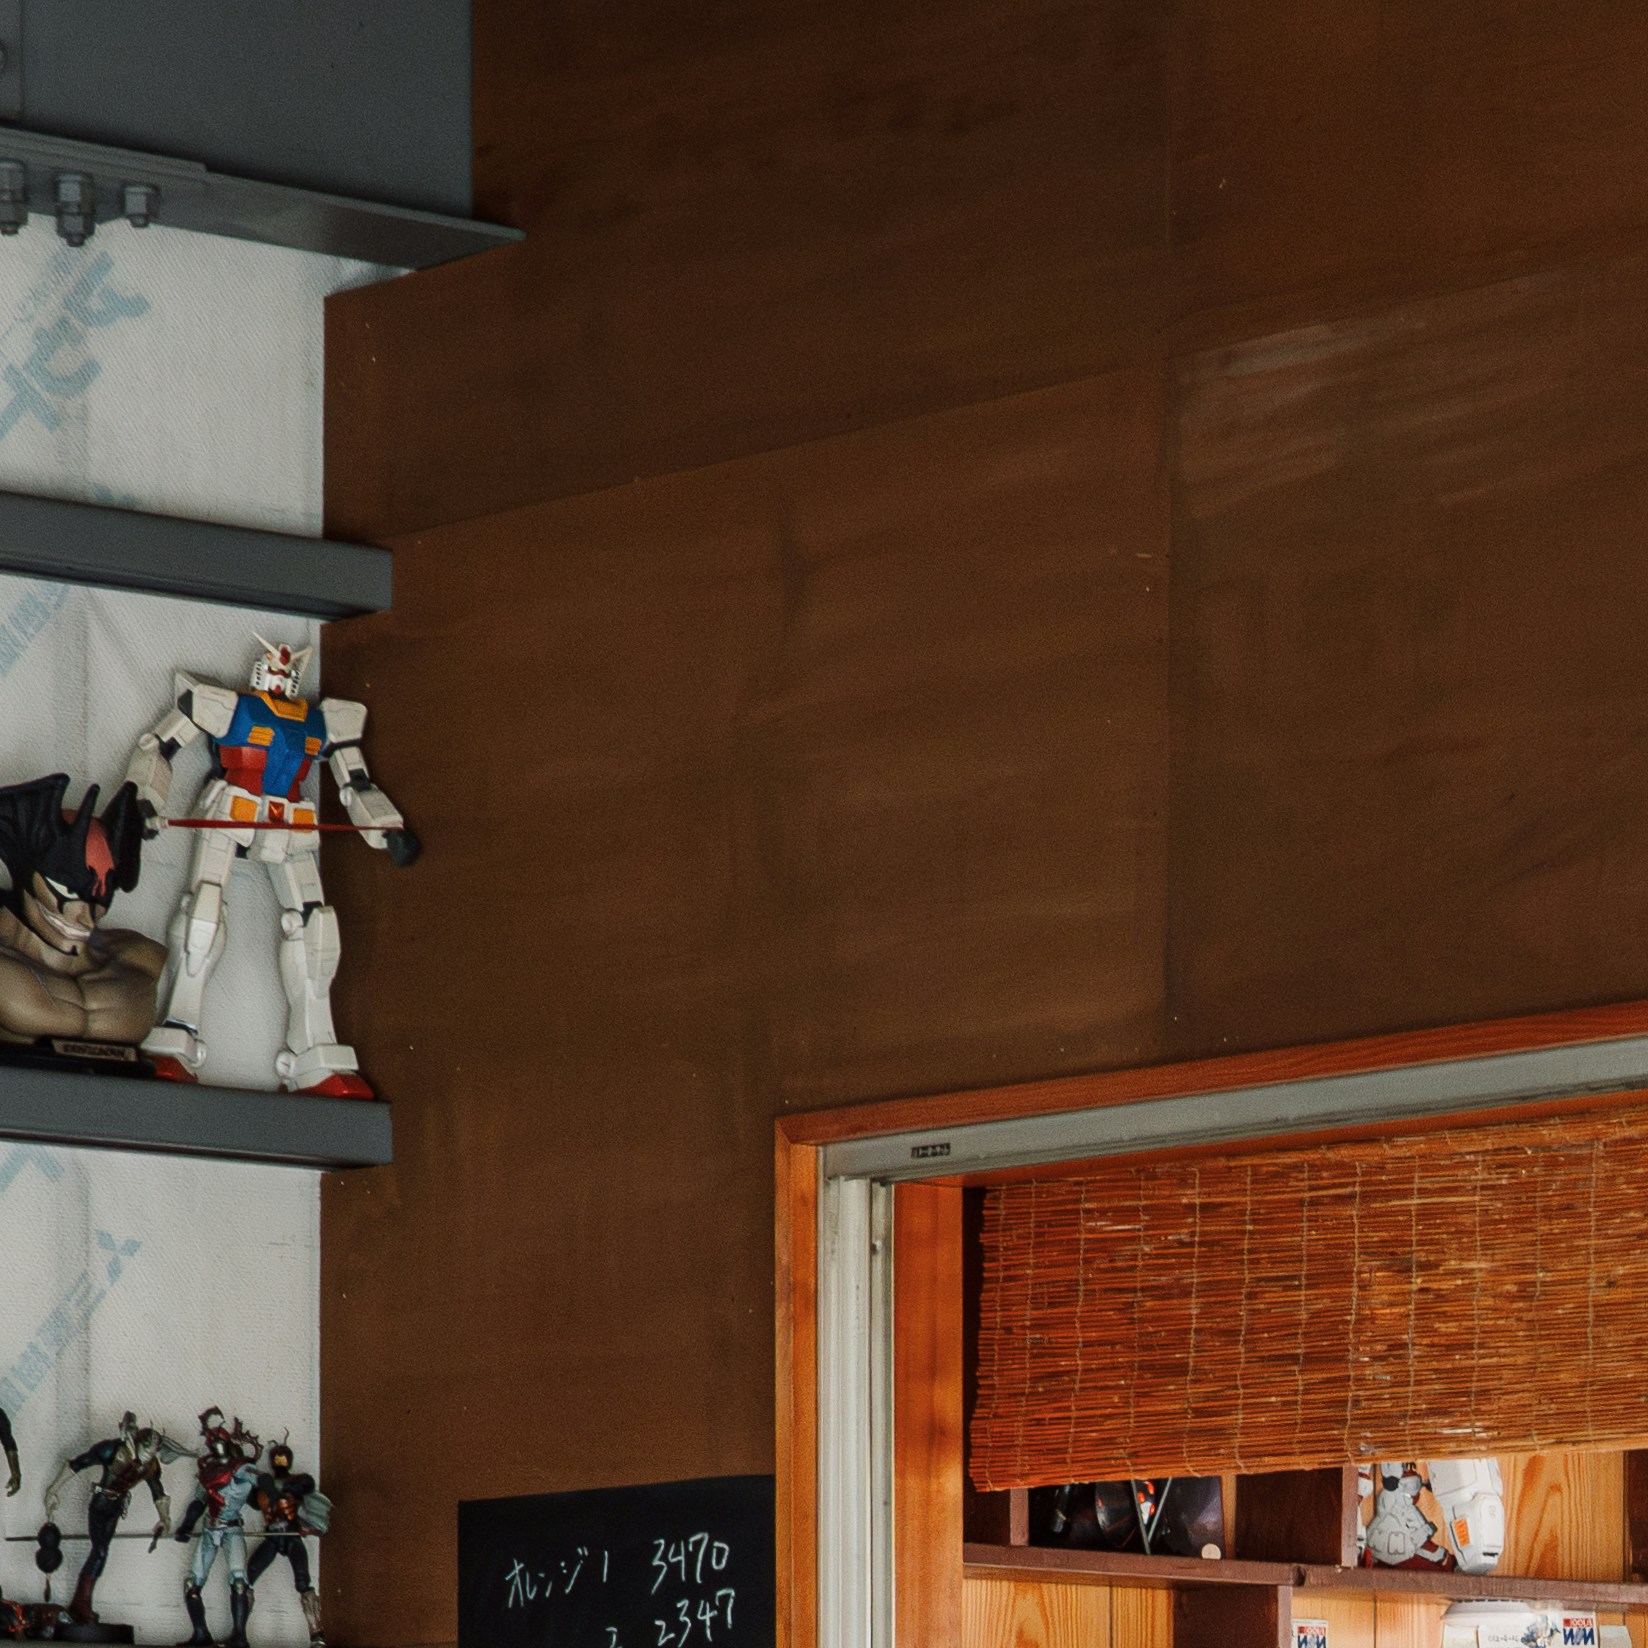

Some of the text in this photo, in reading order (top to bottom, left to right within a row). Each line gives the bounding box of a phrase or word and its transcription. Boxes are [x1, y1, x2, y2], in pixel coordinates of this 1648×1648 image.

[505, 1546, 588, 1609] オレンジ
[651, 1532, 729, 1595] 3470
[655, 1587, 735, 1648] 2347
